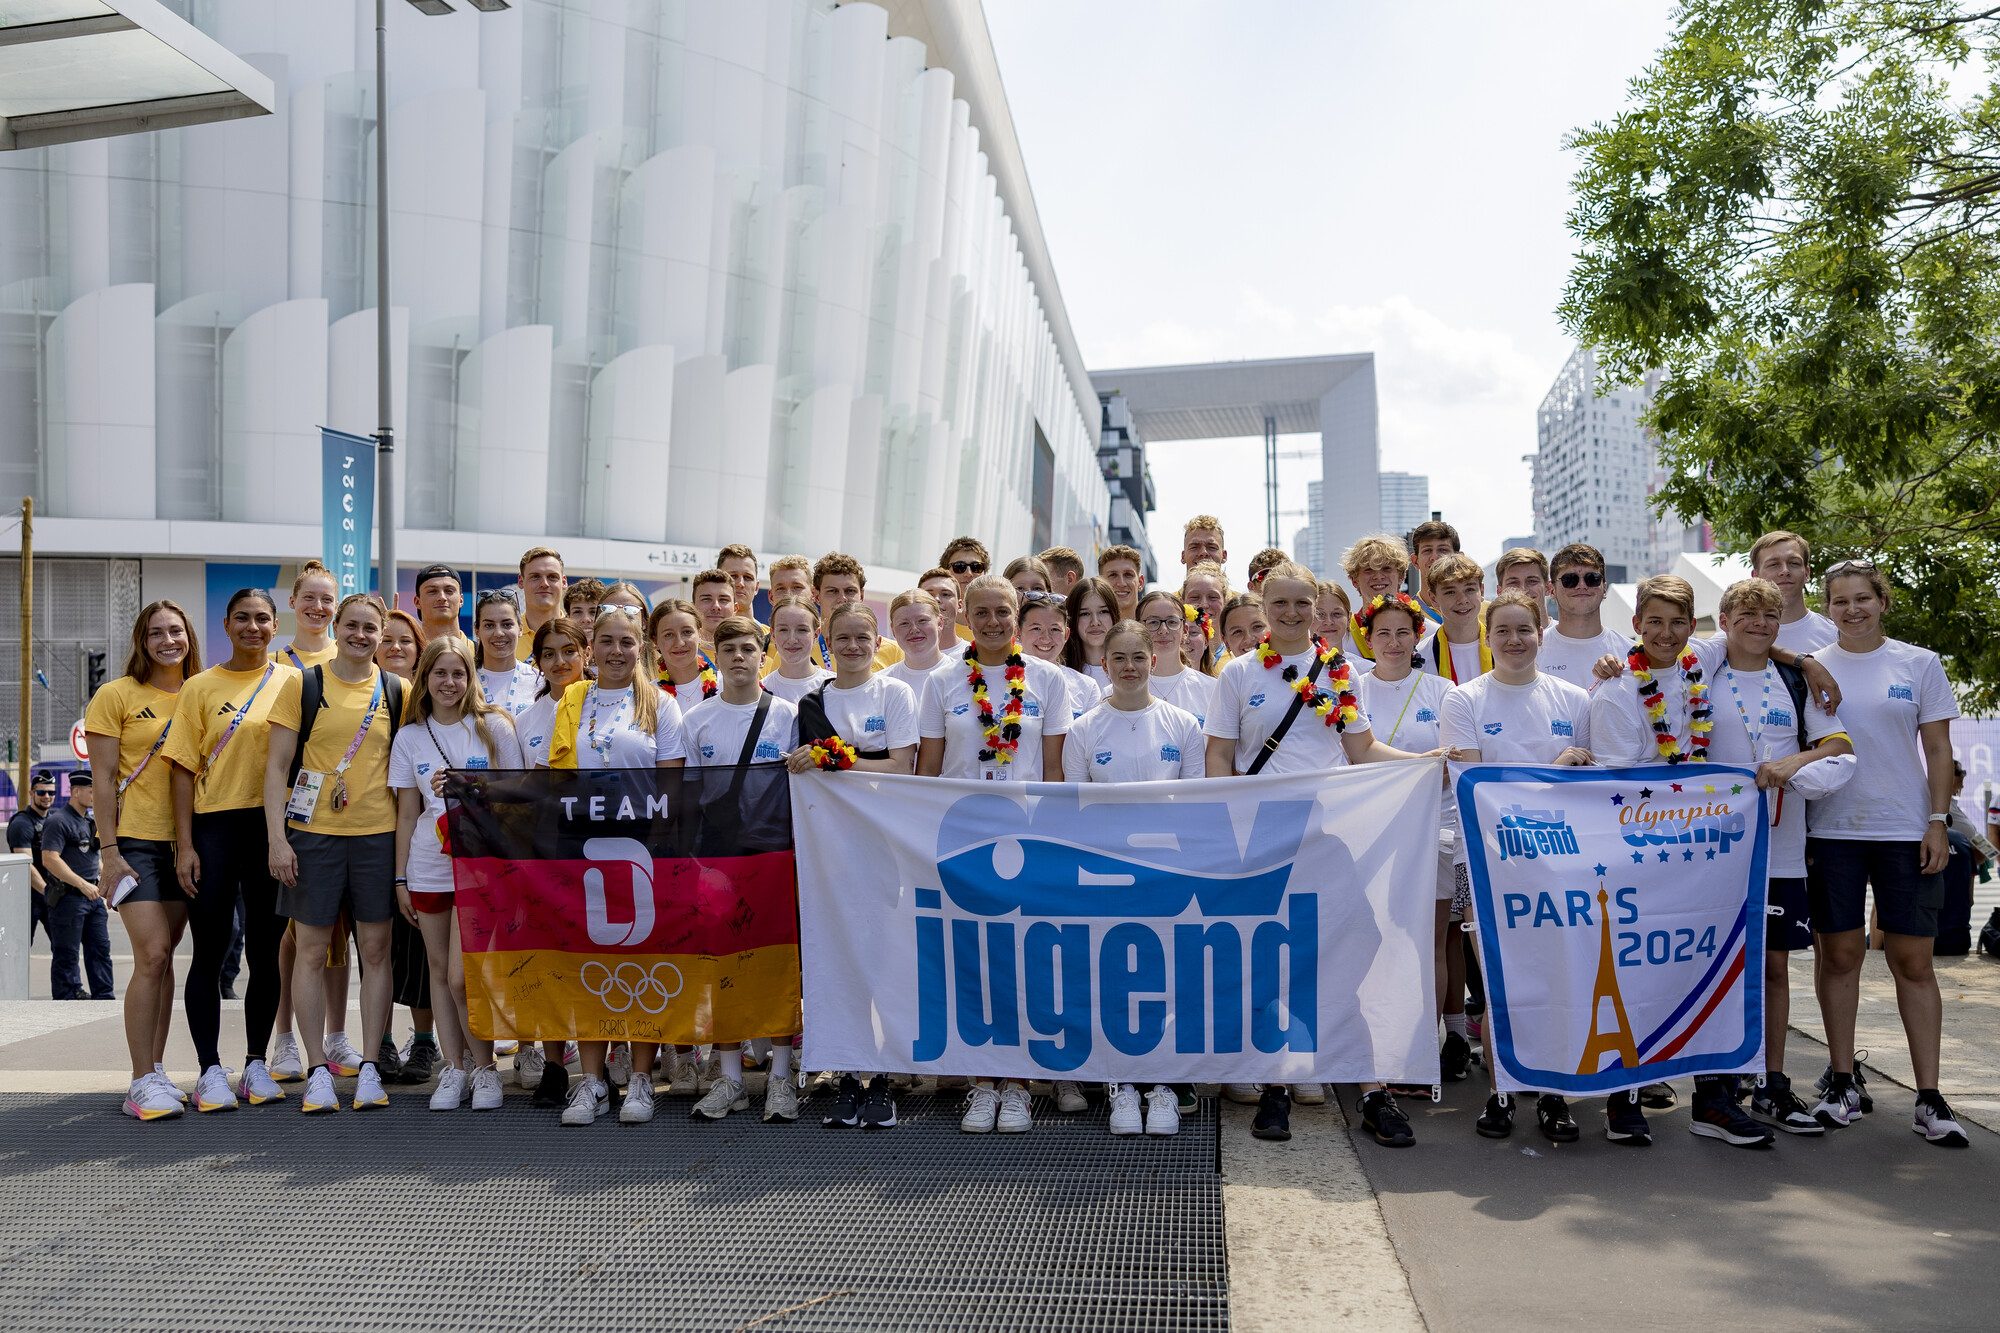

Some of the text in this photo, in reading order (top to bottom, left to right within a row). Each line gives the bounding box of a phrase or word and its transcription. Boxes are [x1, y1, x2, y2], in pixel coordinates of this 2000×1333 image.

[342, 456, 355, 532] 2024
[683, 552, 696, 563] 24
[1484, 722, 1502, 730] arena
[1766, 714, 1792, 727] jugend
[755, 746, 780, 759] jugend
[560, 793, 669, 821] TEAM
[1618, 801, 1734, 830] Olympia
[1496, 824, 1581, 861] jugend
[1617, 925, 1717, 967] 2024
[912, 887, 1318, 1072] jugend
[632, 1019, 662, 1038] 2024
